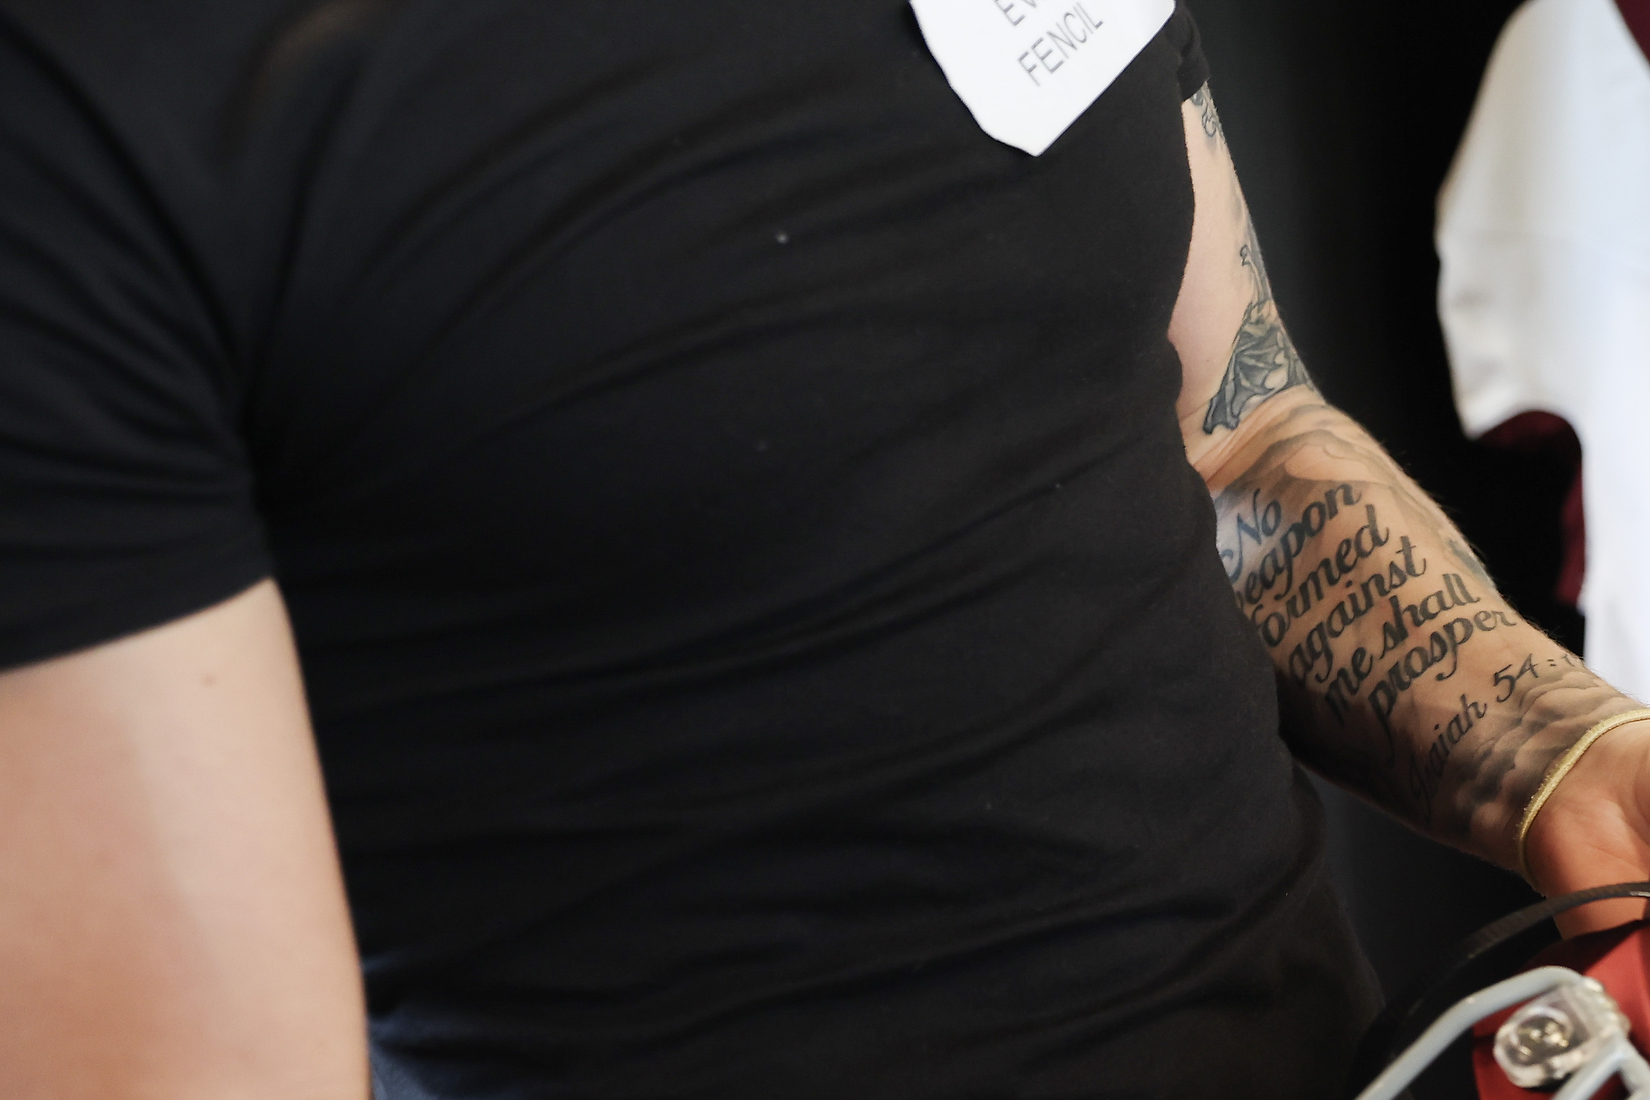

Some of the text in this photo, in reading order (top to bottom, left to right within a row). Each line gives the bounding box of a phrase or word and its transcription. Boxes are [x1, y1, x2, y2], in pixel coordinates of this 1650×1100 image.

[1017, 2, 1104, 86] FENCIL
[1219, 488, 1282, 586] No
[1235, 484, 1362, 613] eapon
[1289, 535, 1427, 690] against
[1379, 573, 1481, 660] shall
[1368, 610, 1517, 768] prosper
